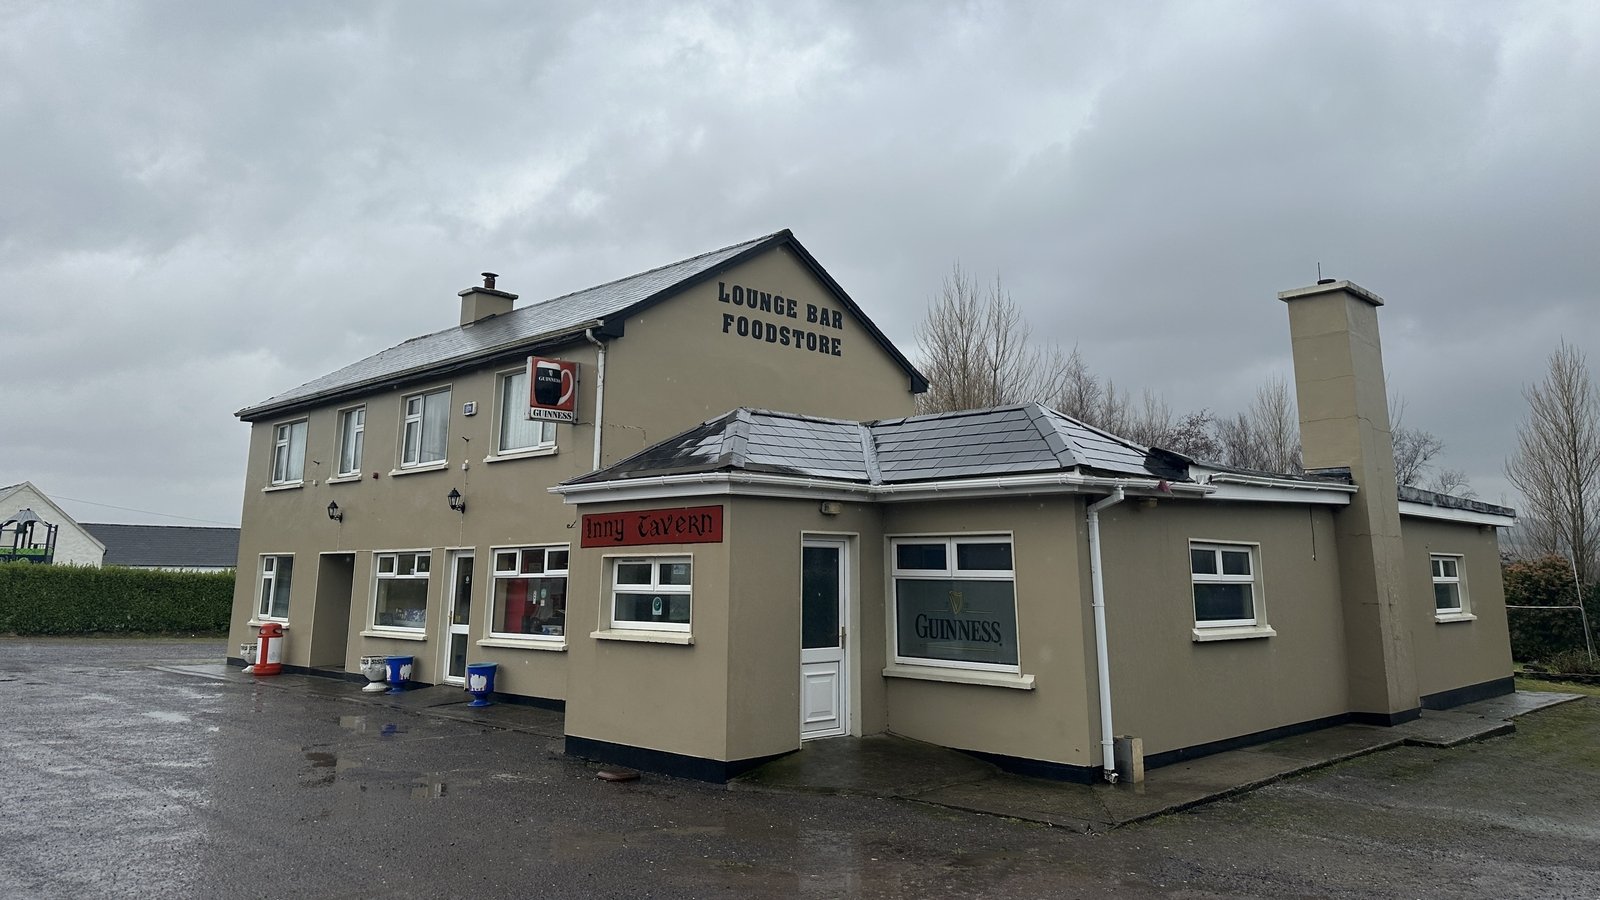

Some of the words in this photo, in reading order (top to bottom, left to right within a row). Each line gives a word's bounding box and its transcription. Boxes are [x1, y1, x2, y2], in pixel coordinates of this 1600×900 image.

[718, 281, 798, 319] LOUNGE
[806, 303, 843, 330] BAR
[722, 313, 842, 357] FOODSTORE
[533, 408, 572, 420] GUINNESS
[586, 518, 624, 542] Inny
[915, 613, 1001, 643] GUINNESS
